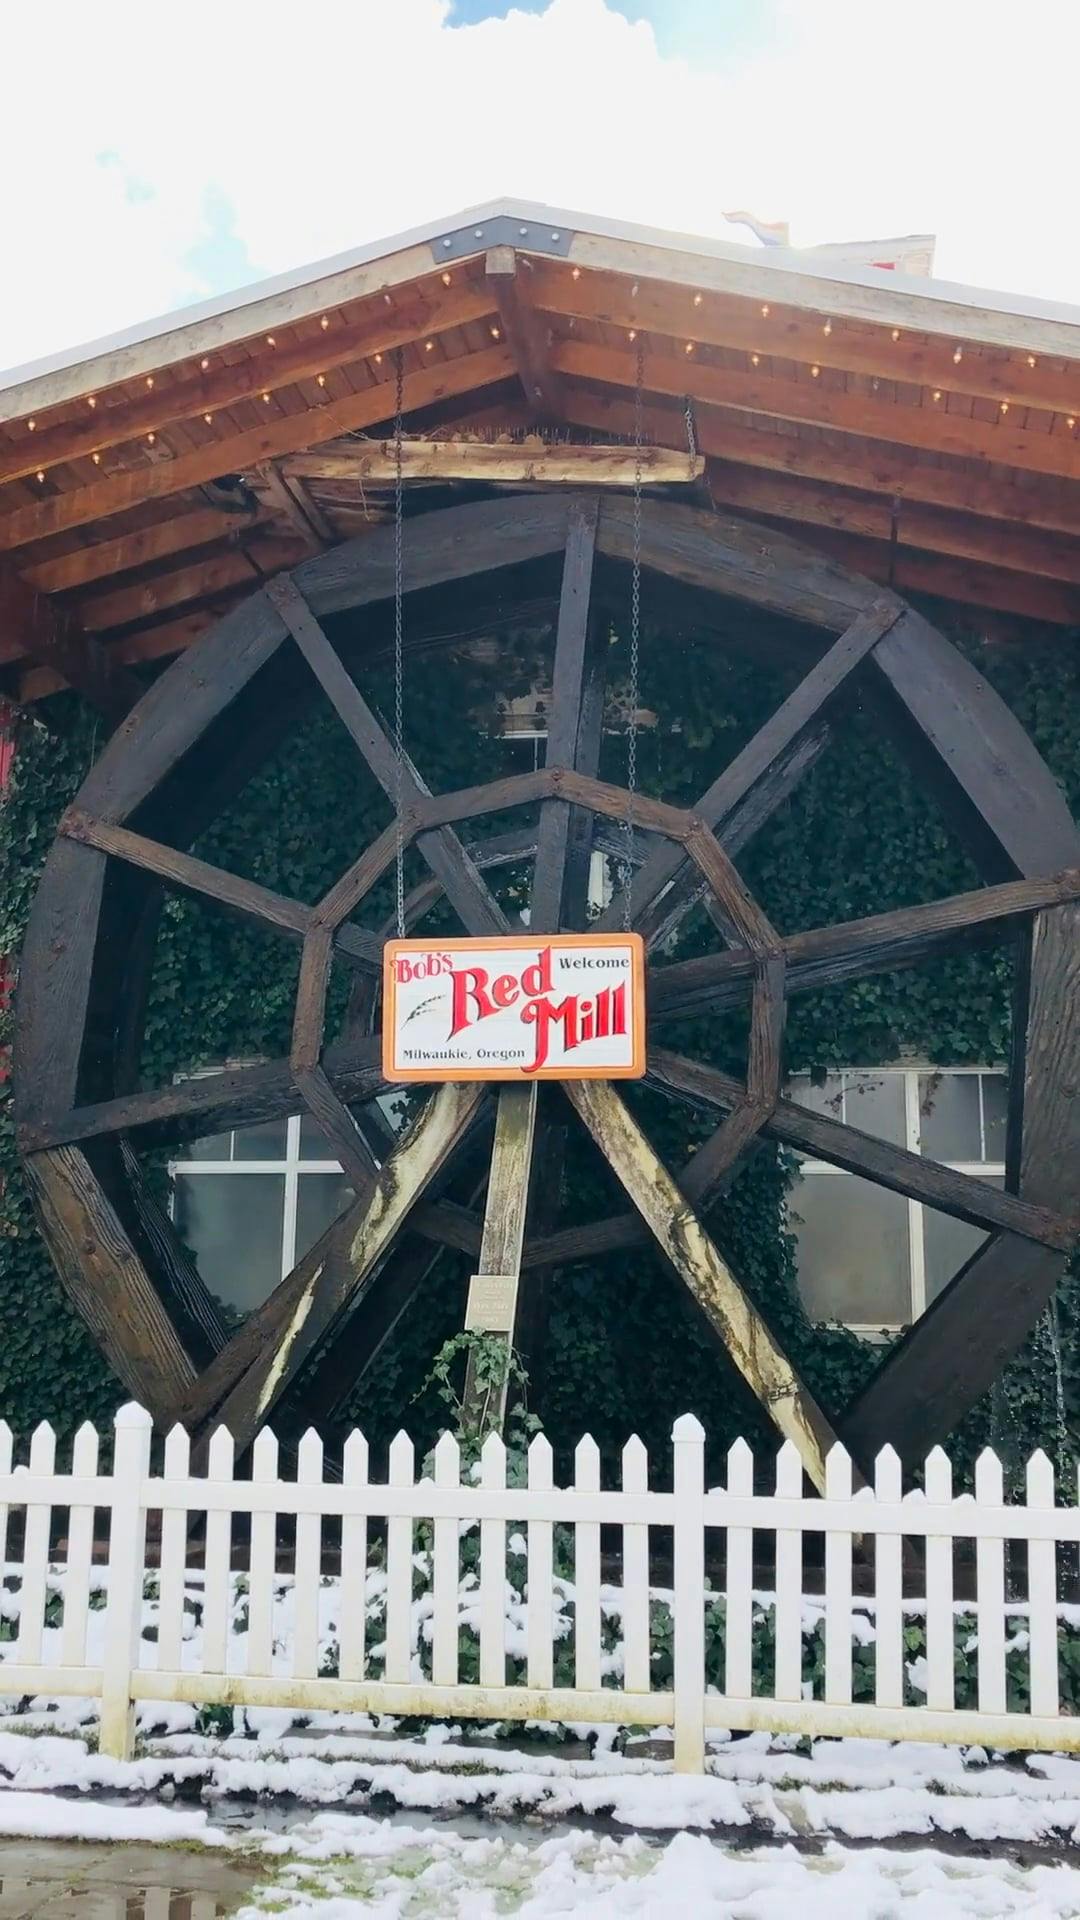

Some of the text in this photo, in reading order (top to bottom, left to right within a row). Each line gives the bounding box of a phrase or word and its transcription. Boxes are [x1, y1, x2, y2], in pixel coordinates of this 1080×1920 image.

[390, 952, 454, 983] Bob's
[559, 957, 629, 969] Welcome
[445, 945, 556, 1042] Red
[520, 979, 627, 1073] Mill
[403, 1048, 526, 1062] Milwaukie, Oregon
